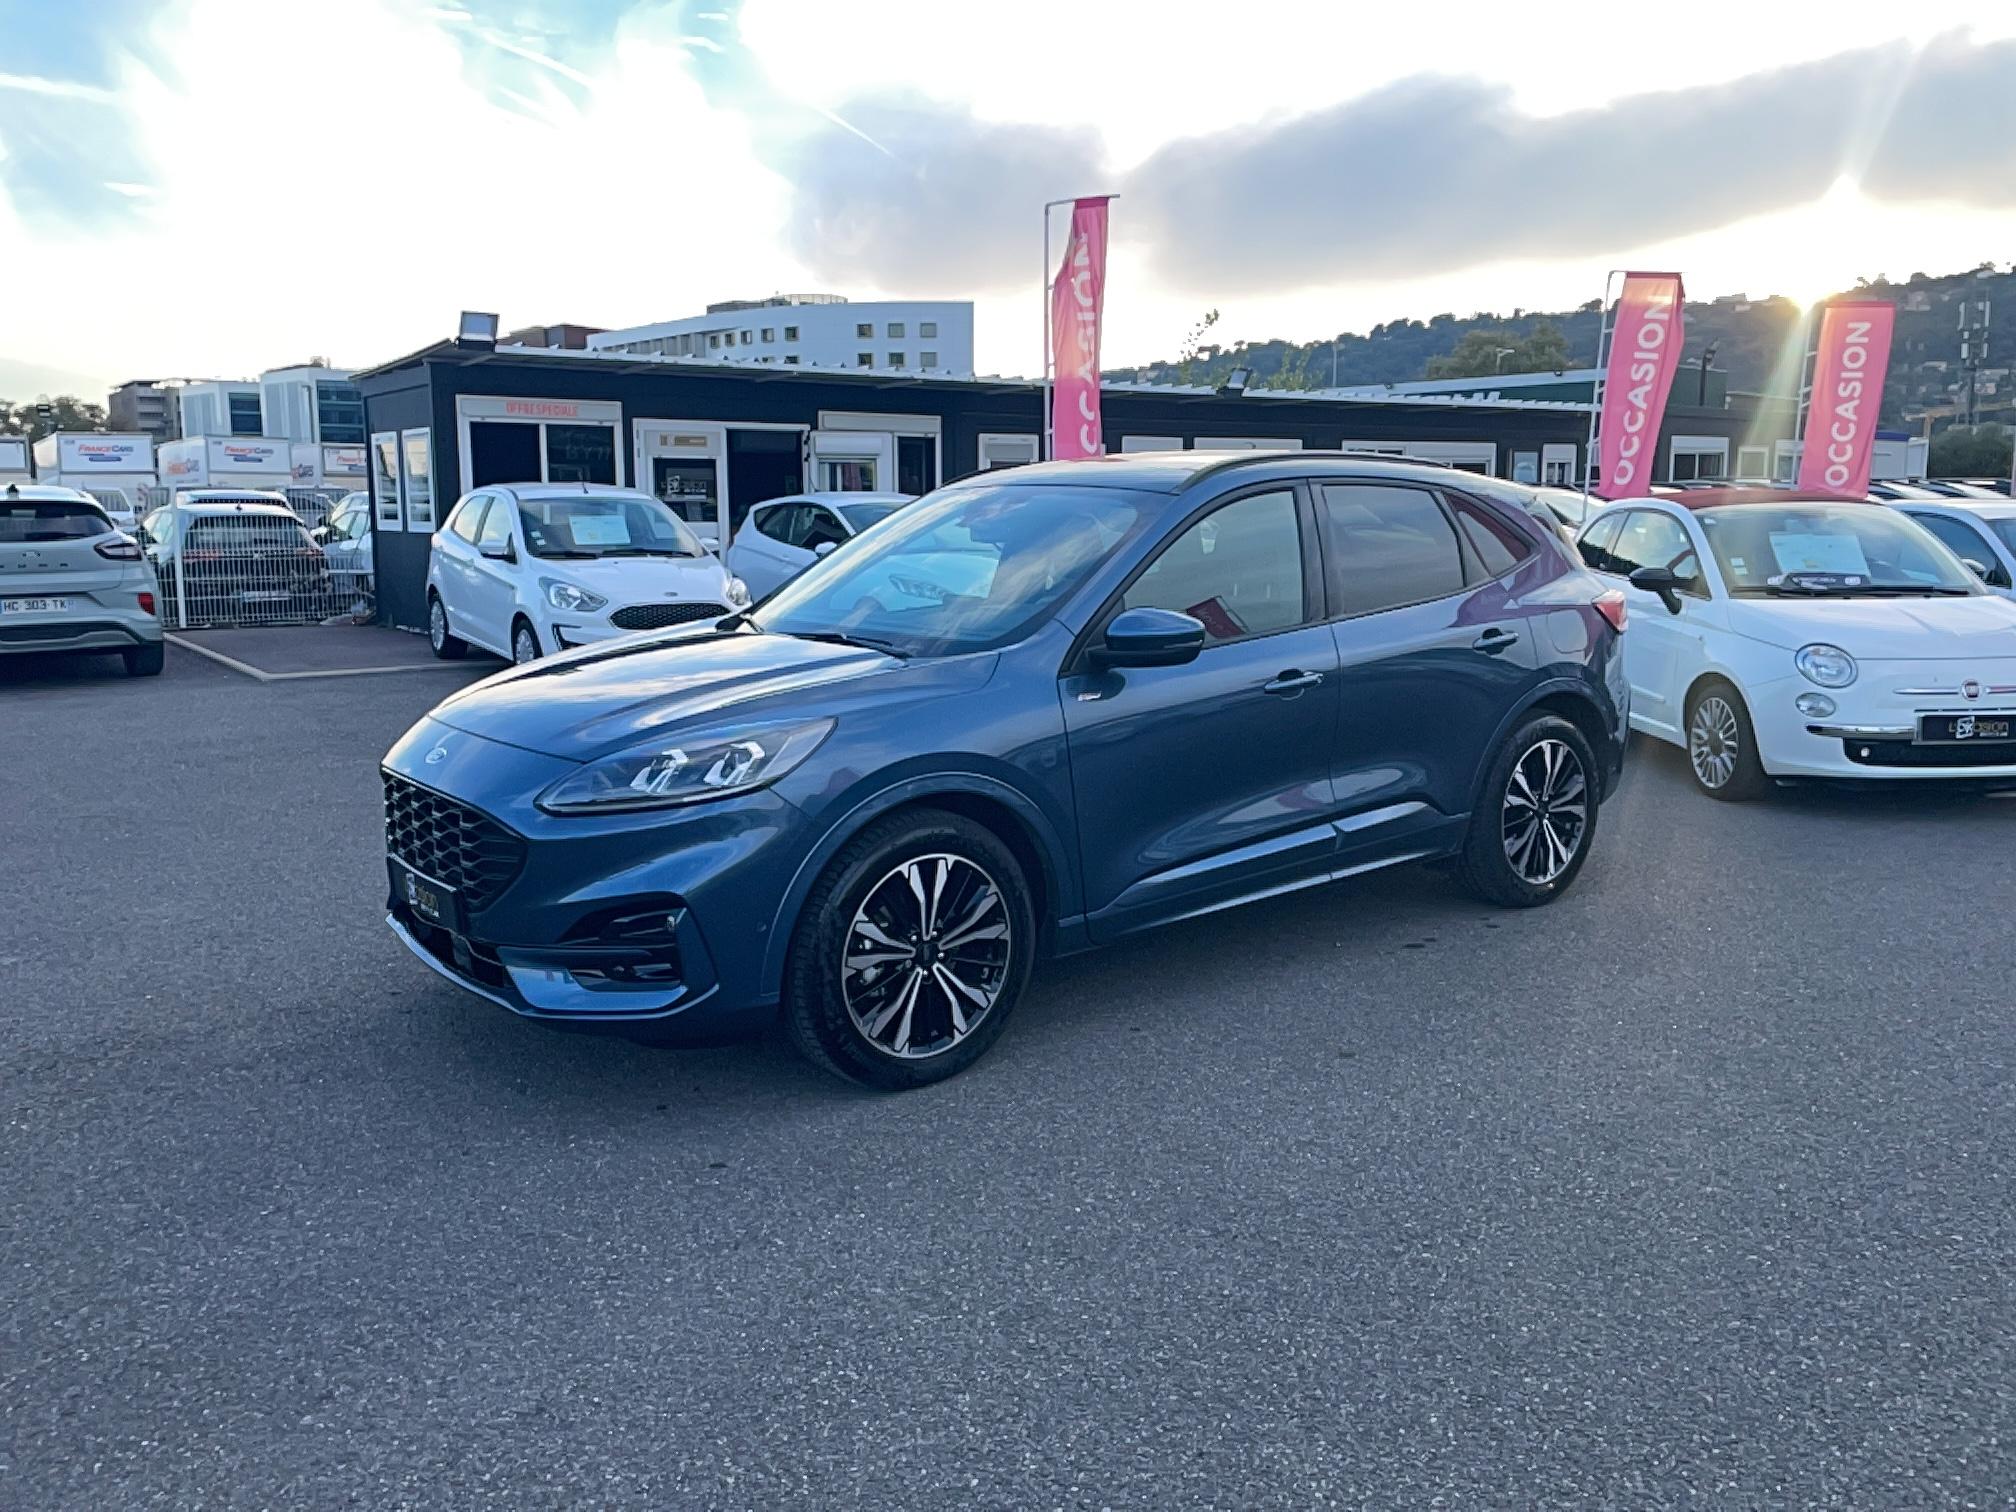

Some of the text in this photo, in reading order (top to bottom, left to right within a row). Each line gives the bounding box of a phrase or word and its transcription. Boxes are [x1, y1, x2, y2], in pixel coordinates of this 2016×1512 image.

[1072, 231, 1098, 455] CCASION
[1613, 297, 1671, 486] OCCASION
[1824, 321, 1872, 487] OCCASION
[25, 600, 47, 610] 303
[53, 599, 67, 609] TK
